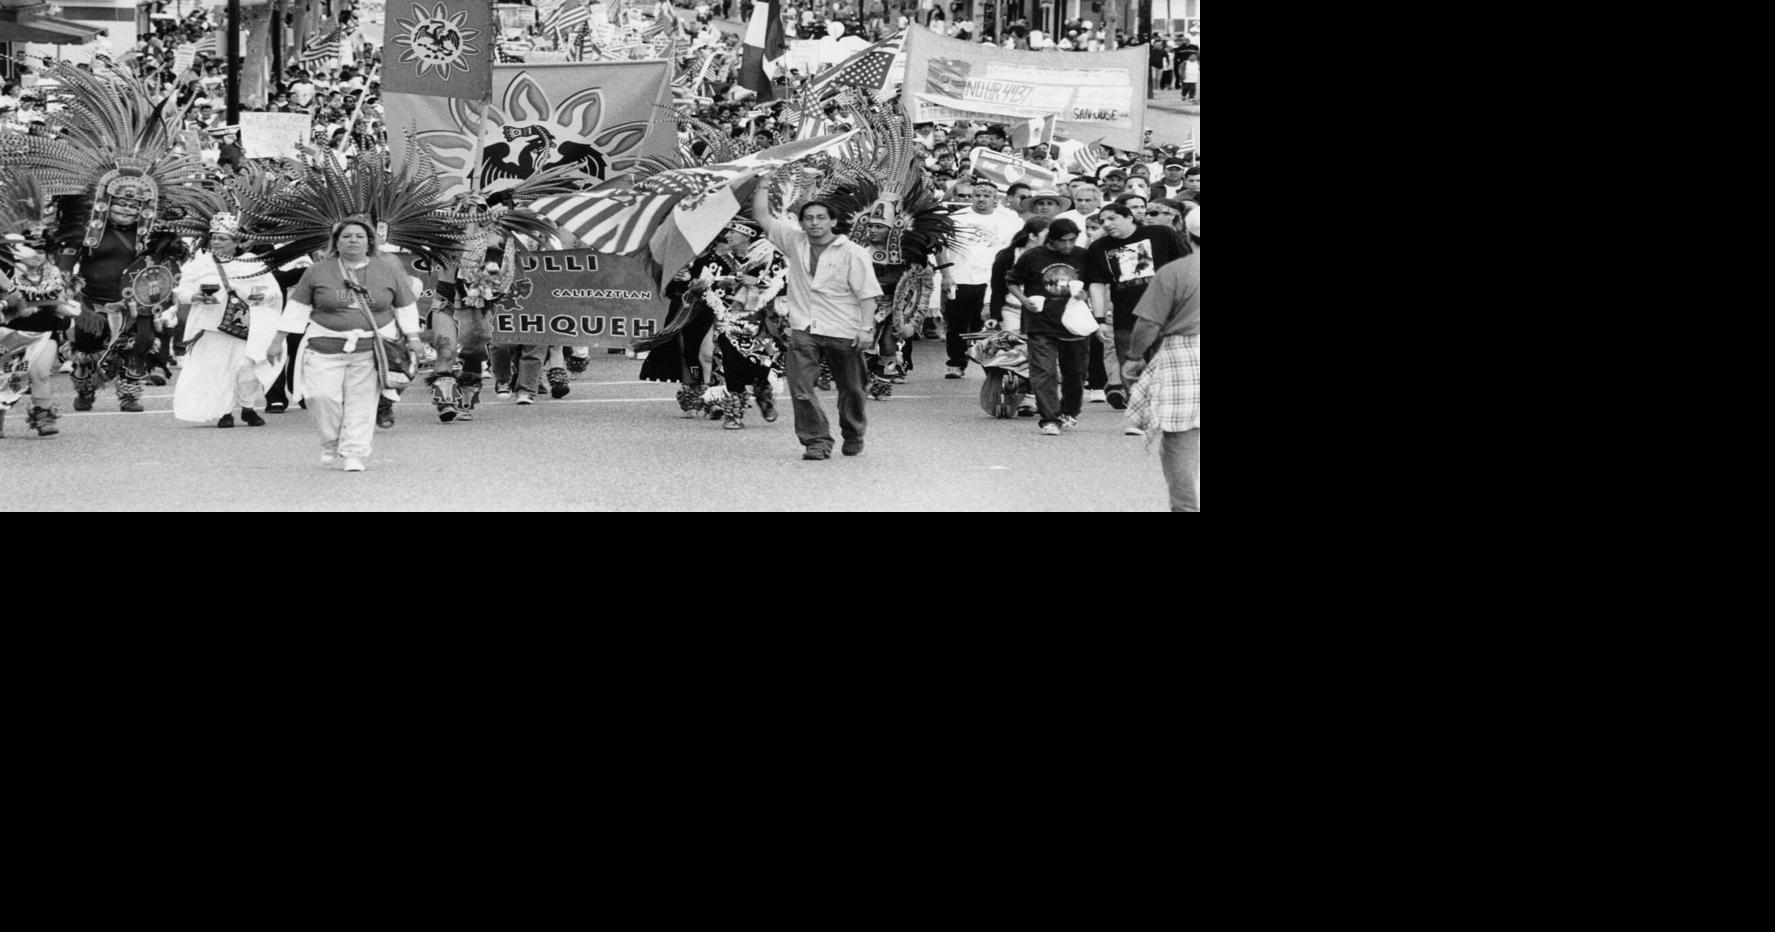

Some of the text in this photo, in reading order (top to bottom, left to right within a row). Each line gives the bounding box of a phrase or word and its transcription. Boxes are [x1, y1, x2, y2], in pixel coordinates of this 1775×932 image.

[1073, 107, 1092, 120] SAN
[551, 288, 653, 300] CALIFAZTLAN
[489, 313, 657, 337] EHQUEH
